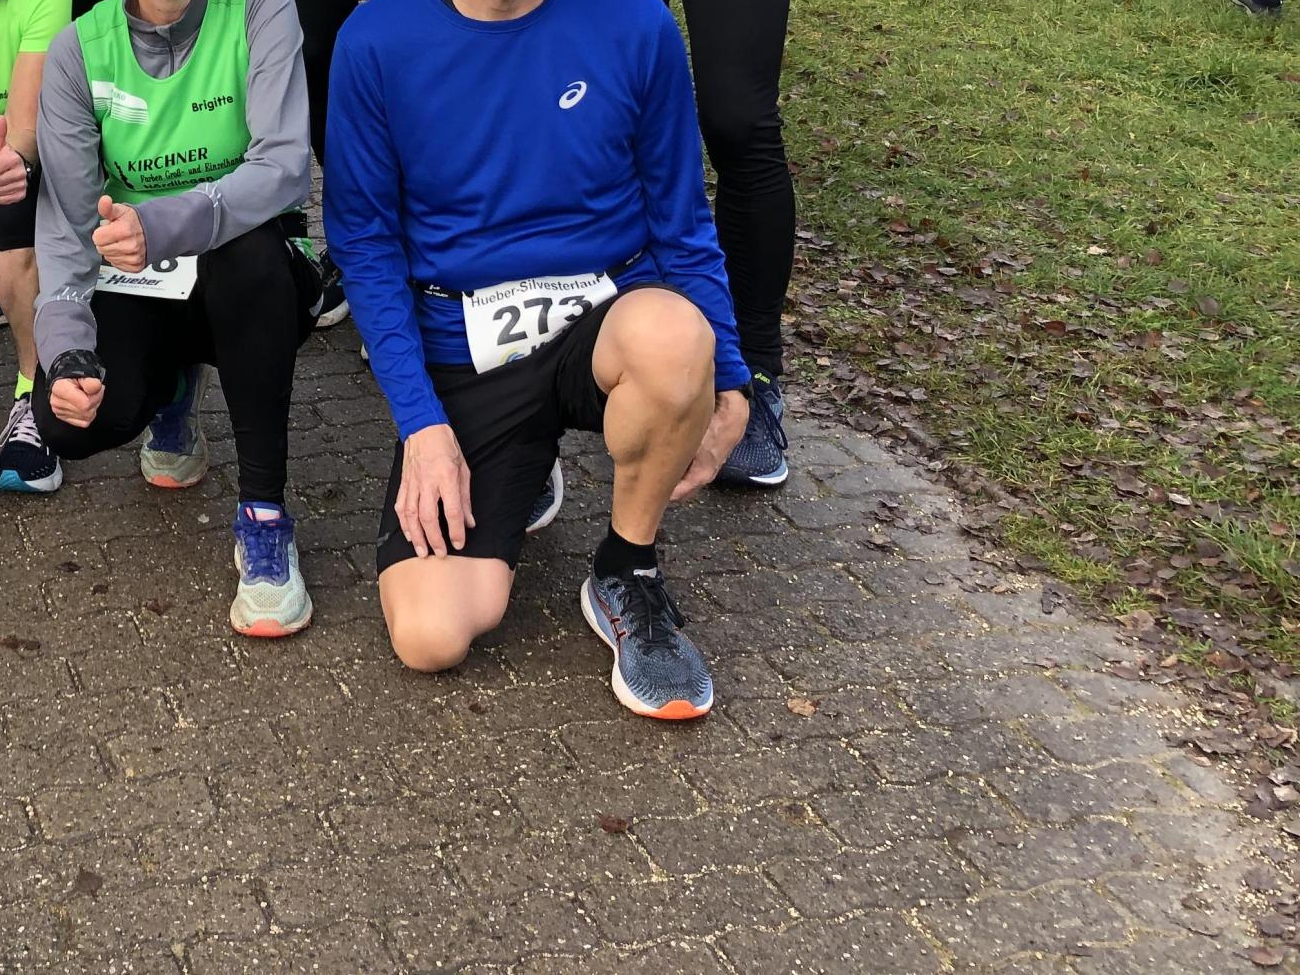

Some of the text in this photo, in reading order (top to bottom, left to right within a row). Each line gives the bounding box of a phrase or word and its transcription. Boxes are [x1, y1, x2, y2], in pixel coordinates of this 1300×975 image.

[191, 95, 234, 112] Brigitte
[127, 147, 209, 172] KIRCHNER
[188, 166, 202, 175] und
[204, 155, 244, 173] Einzelhand
[105, 274, 163, 286] Hueber
[492, 295, 593, 346] 273
